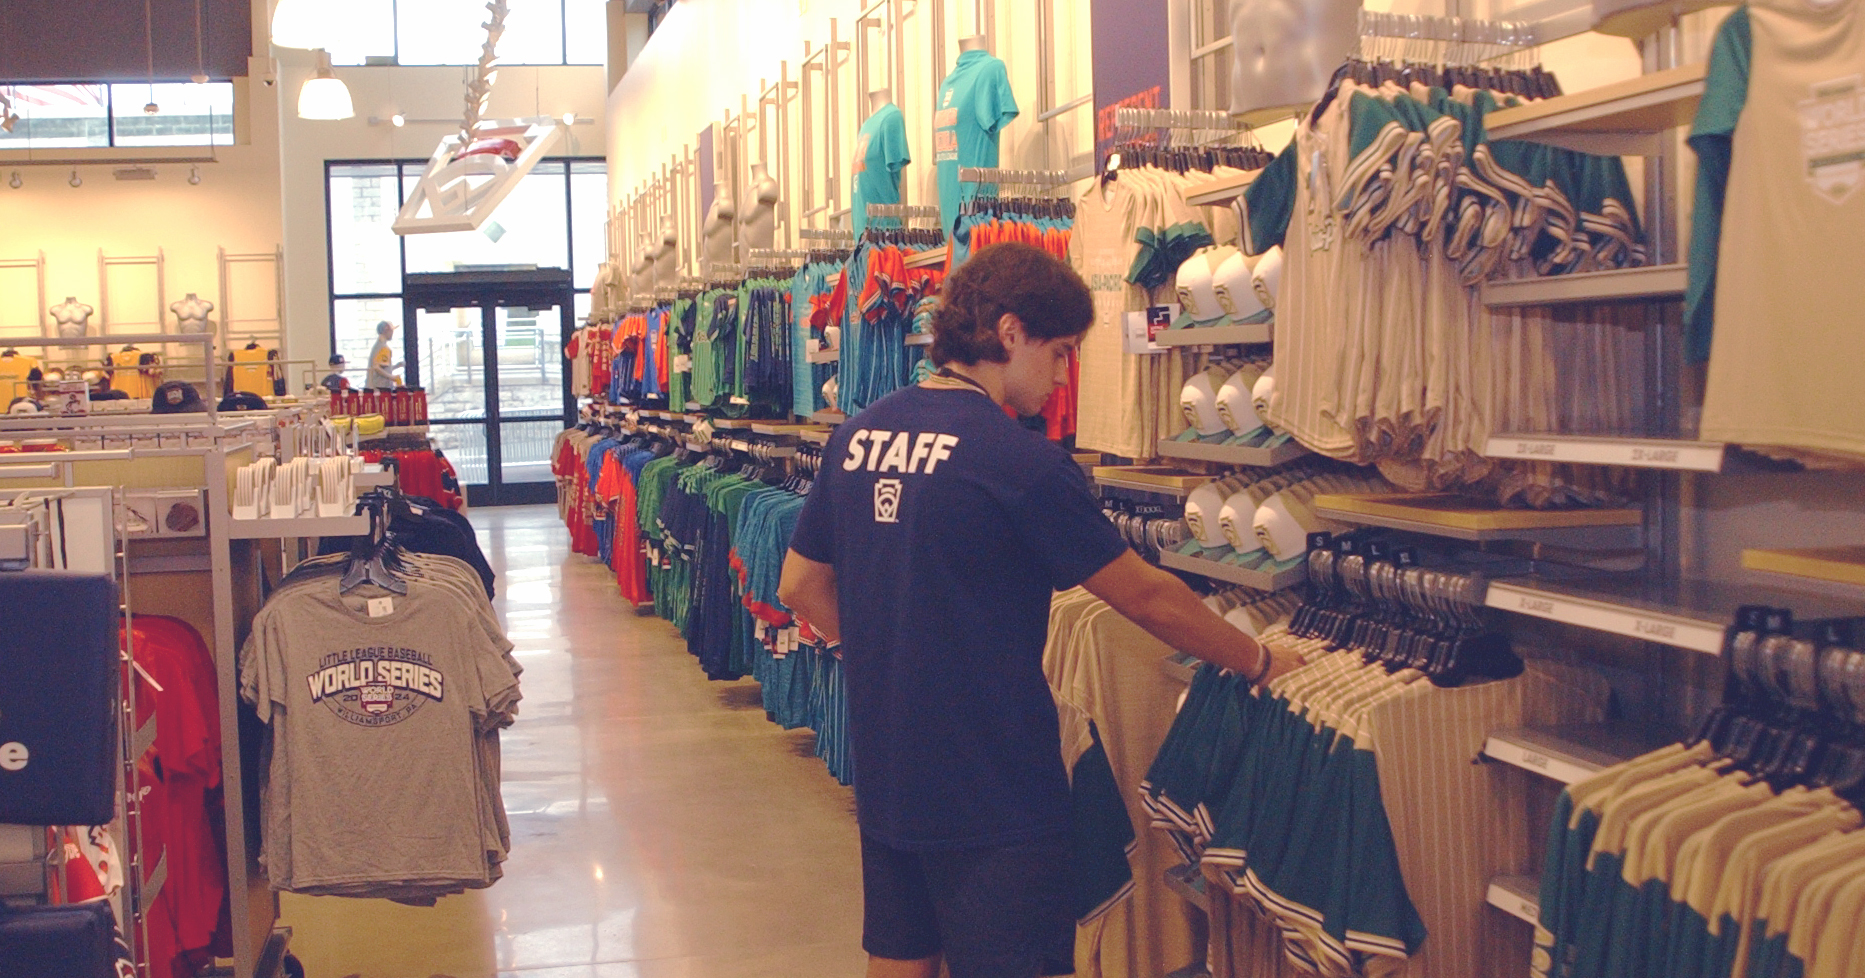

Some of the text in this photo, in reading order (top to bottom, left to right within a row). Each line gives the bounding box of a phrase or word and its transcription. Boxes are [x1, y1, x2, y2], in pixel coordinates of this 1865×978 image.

[842, 428, 960, 475] STAFF
[1104, 499, 1113, 508] M
[1315, 535, 1324, 547] S
[1341, 540, 1352, 552] M
[1370, 544, 1380, 556] L
[319, 647, 434, 668] LITTLE LEAGUE BASEBALL
[307, 659, 444, 702] WORLD SERIES
[342, 693, 410, 702] 20 24
[405, 703, 418, 715] PA
